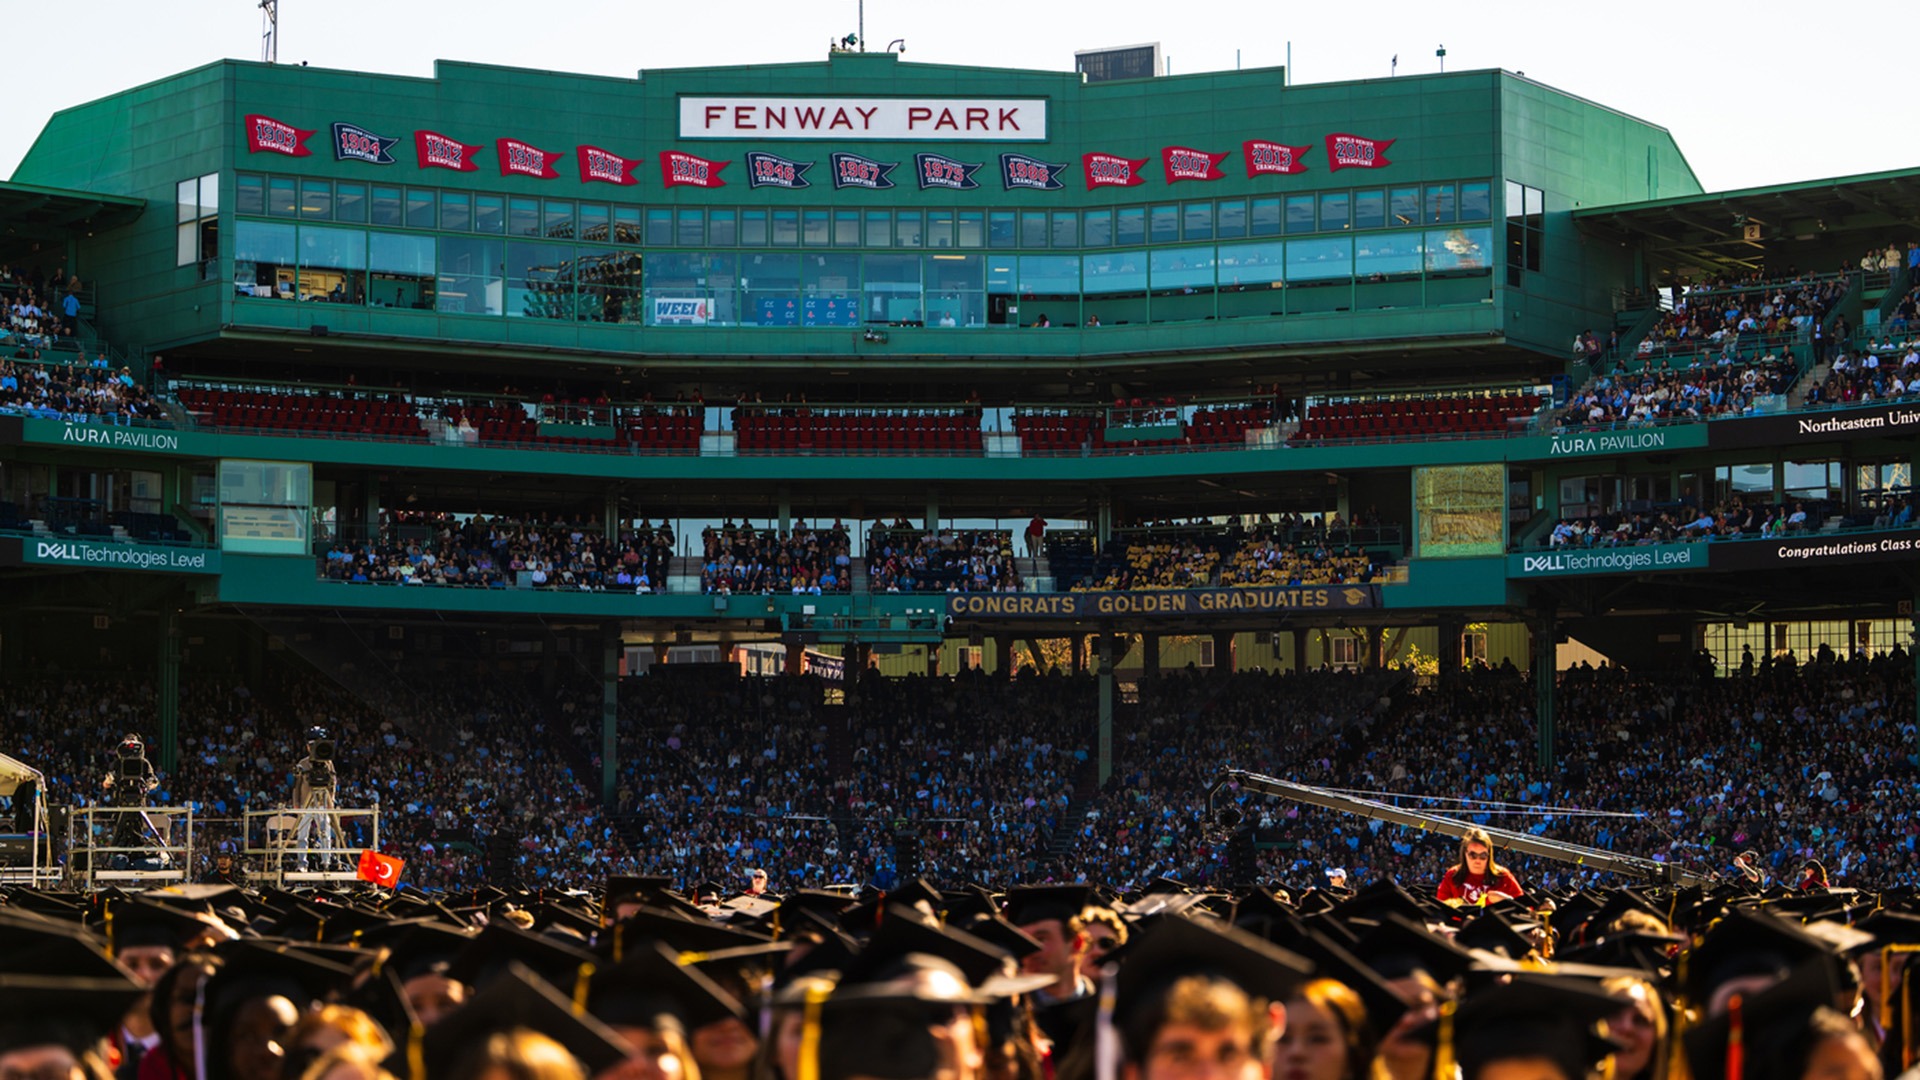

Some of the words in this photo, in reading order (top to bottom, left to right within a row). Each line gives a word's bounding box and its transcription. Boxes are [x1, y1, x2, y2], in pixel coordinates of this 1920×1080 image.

[705, 106, 878, 130] FENWAY
[908, 107, 1020, 131] PARK
[256, 124, 296, 148] 1903
[427, 140, 462, 163] 1912
[509, 147, 543, 170] 1915
[1252, 149, 1292, 167] 2013
[1335, 143, 1374, 160] 2018
[589, 155, 622, 176] 1916
[755, 161, 794, 181] 1946
[840, 161, 880, 181] 1967
[924, 162, 964, 182] 1975
[1090, 162, 1130, 180] 2004
[1170, 155, 1210, 174] 2007
[656, 302, 697, 315] WEEI
[1799, 416, 1884, 434] Northeastern
[114, 431, 178, 449] PAVILION
[1600, 433, 1664, 449] PAVILION
[1655, 548, 1690, 564] Level
[1778, 541, 1877, 559] Congratulations
[1880, 539, 1911, 551] Class
[171, 552, 205, 568] Level
[952, 596, 1075, 613] CONGRATS
[1099, 594, 1187, 613] GOLDEN
[1200, 589, 1329, 610] GRADUATES
